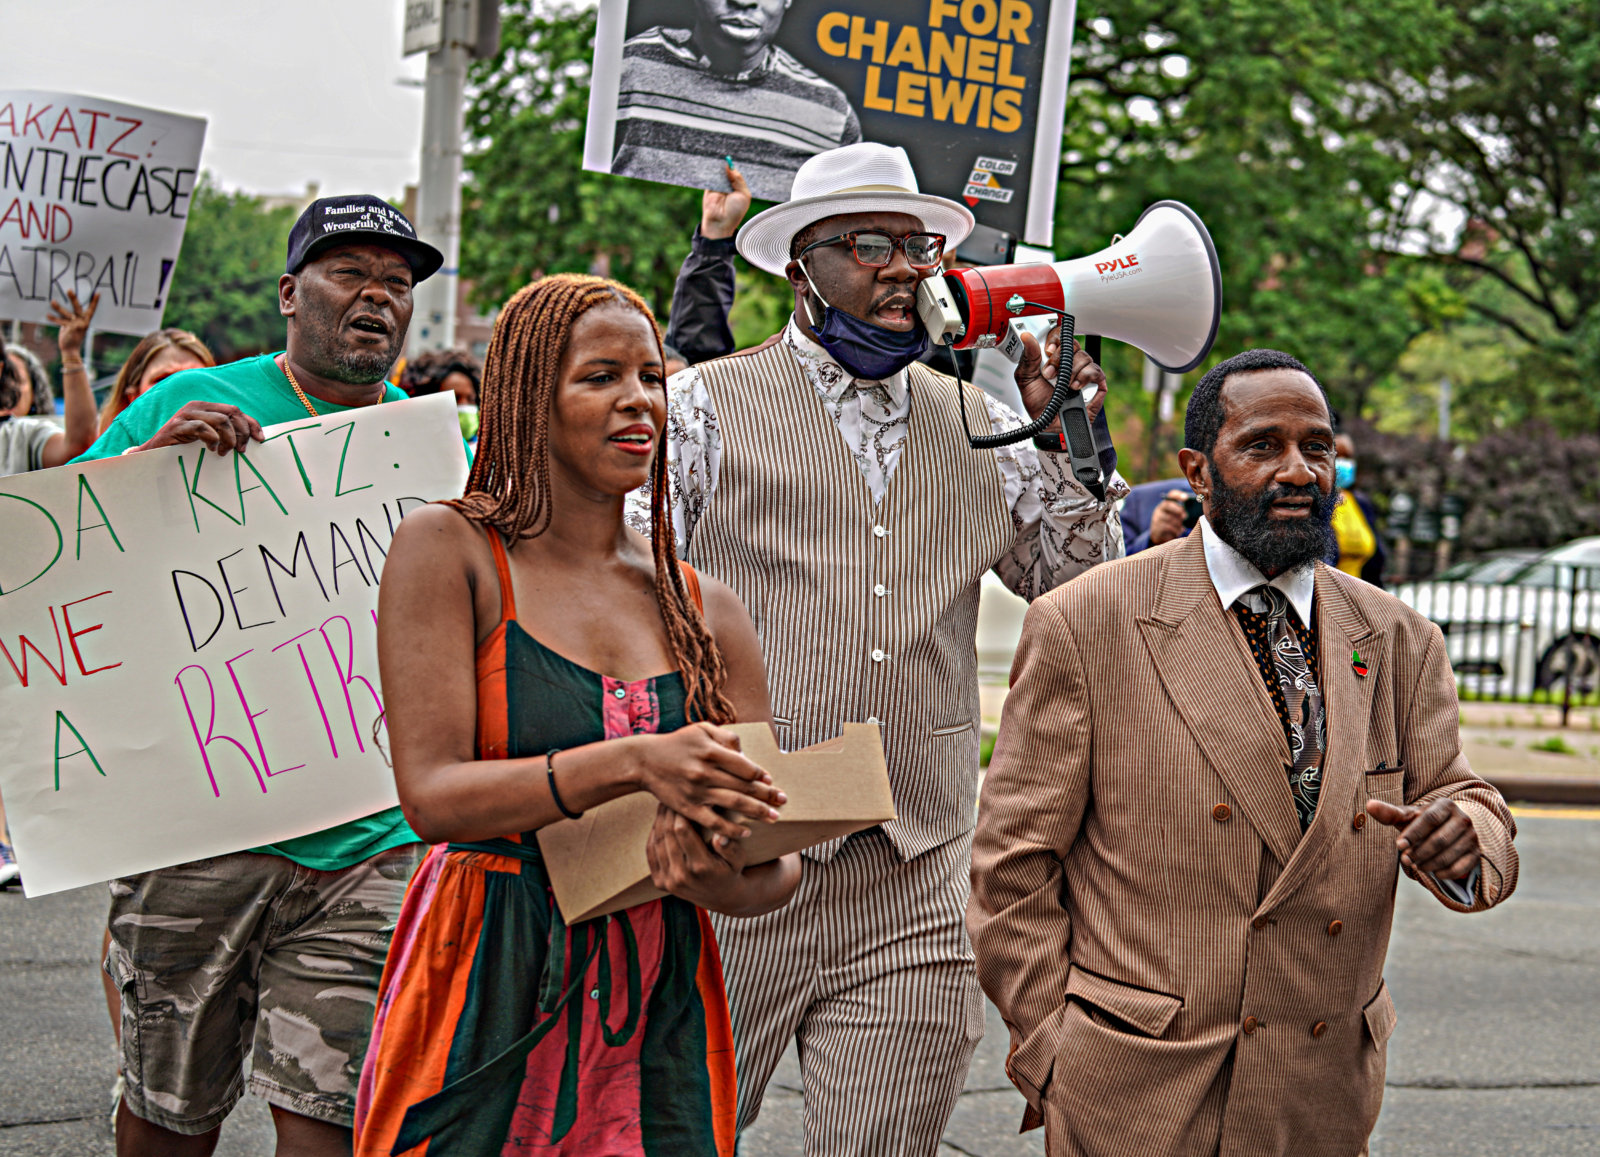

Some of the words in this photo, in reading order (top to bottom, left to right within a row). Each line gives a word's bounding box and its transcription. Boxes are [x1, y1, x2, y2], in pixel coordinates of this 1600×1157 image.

[928, 0, 1033, 45] FOR
[816, 11, 1026, 90] CHANEL
[863, 65, 1023, 133] LEWIS
[978, 159, 1013, 171] COLOR
[972, 172, 988, 182] OF
[966, 185, 1010, 201] CHANGE
[0, 197, 73, 244] AND
[324, 204, 366, 216] Families
[368, 205, 387, 217] and
[360, 212, 371, 221] of
[377, 213, 394, 227] The
[322, 220, 380, 233] Wrongfully
[1095, 254, 1139, 275] PYLE
[1100, 267, 1143, 284] PyleUSA.com
[1005, 334, 1018, 355] PYLE
[0, 473, 125, 596] DA
[178, 421, 401, 534] KATZ:
[0, 590, 123, 687] WE
[54, 710, 107, 792] A
[174, 609, 391, 799] RETR
